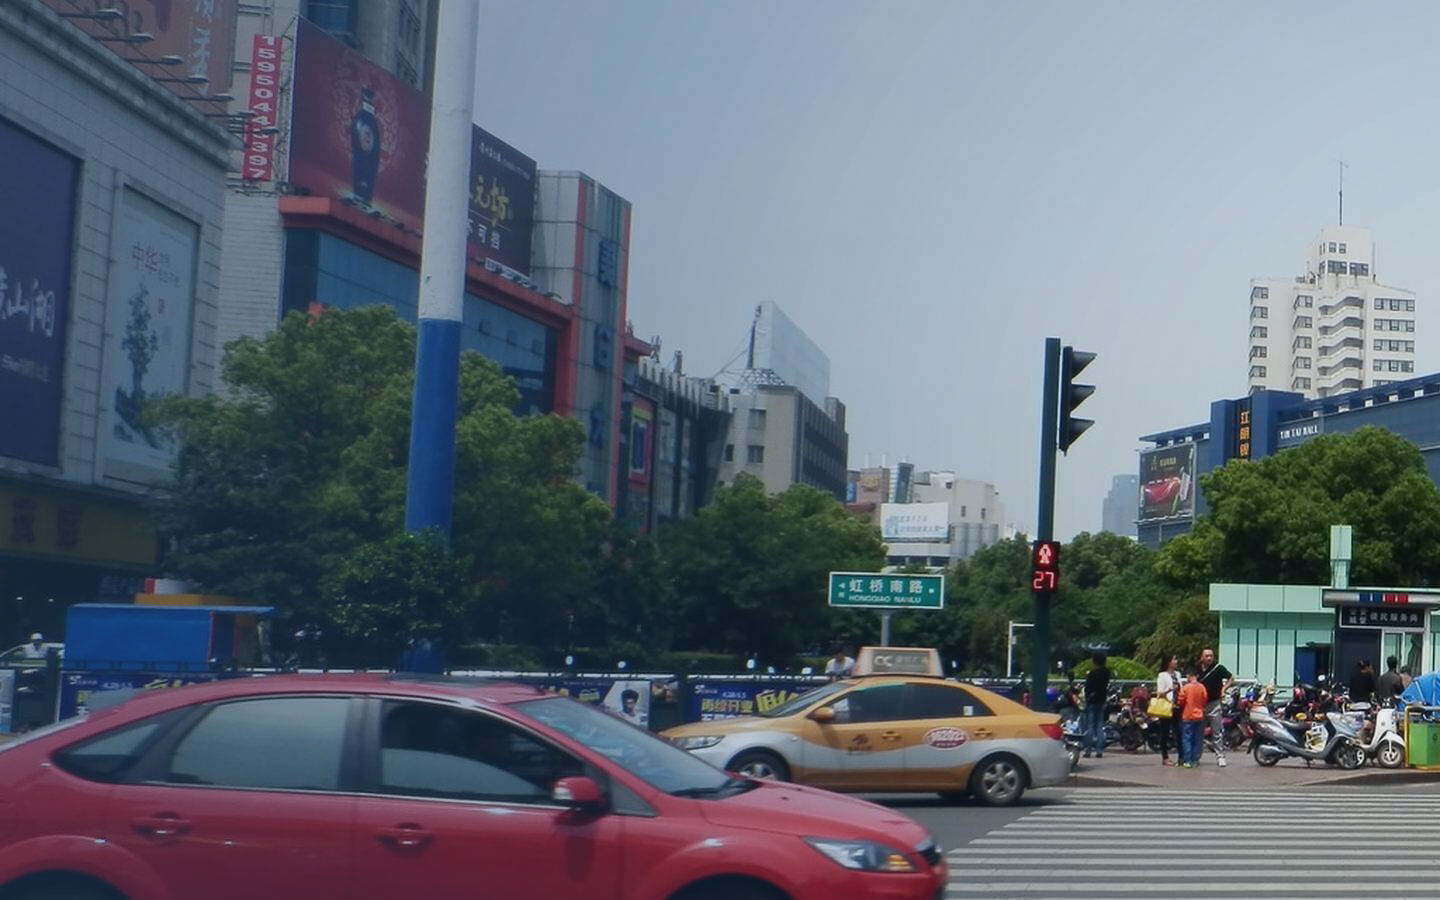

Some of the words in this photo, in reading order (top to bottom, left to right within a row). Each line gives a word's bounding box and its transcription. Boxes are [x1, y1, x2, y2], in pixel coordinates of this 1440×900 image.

[849, 578, 923, 593] 虹桥南路
[1033, 571, 1055, 589] 27
